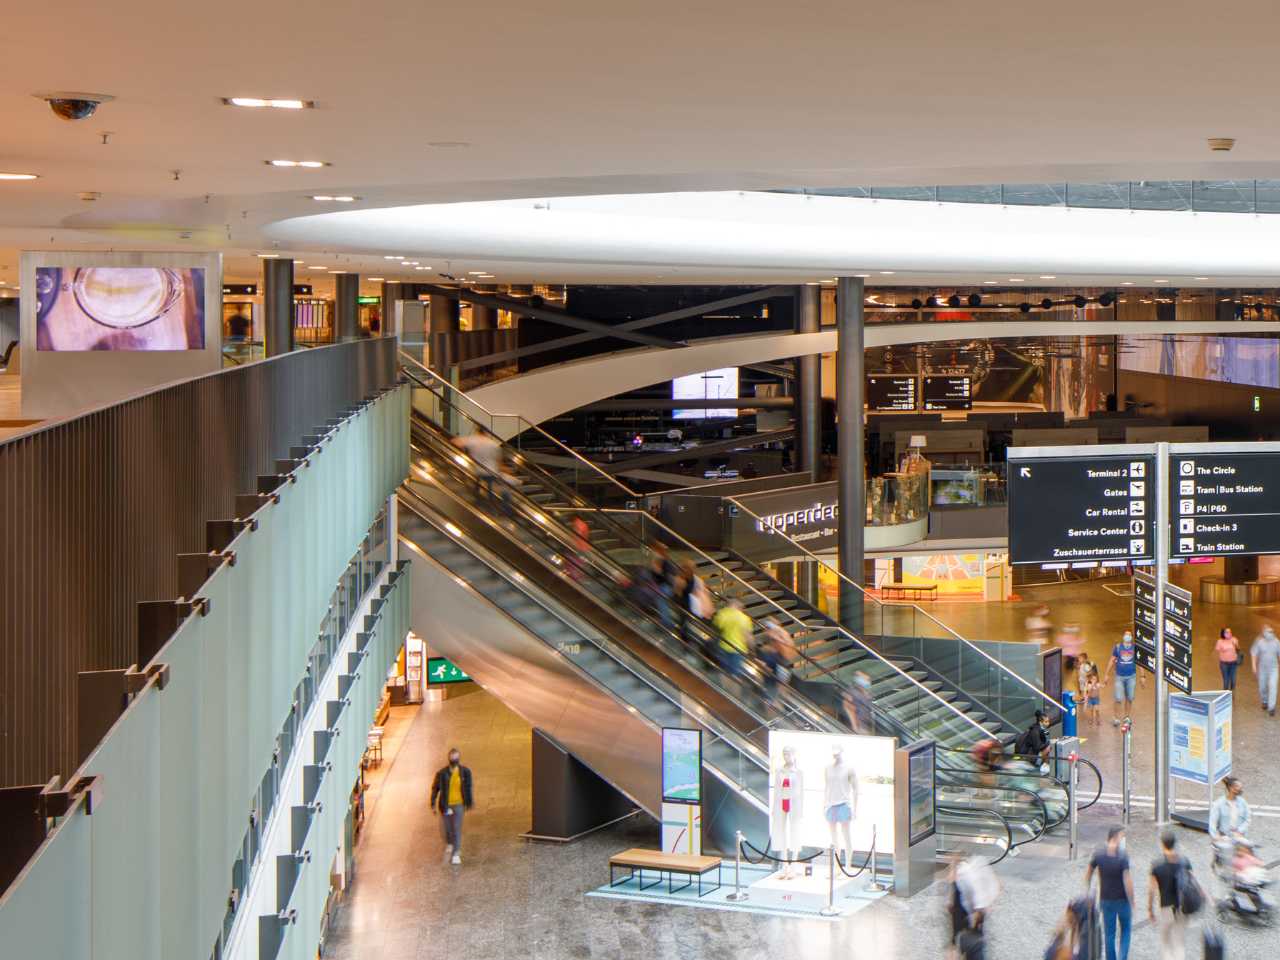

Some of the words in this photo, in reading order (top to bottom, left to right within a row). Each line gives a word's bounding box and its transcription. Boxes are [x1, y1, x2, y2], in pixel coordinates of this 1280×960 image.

[1087, 468, 1120, 478] Terminal
[1122, 469, 1128, 477] 2
[1197, 467, 1211, 475] The
[1213, 466, 1236, 474] Circle
[1235, 485, 1264, 493] Station
[1086, 508, 1100, 516] Car
[1102, 507, 1128, 516] Rental
[1068, 528, 1098, 537] Service
[1100, 527, 1128, 535] Center
[1196, 523, 1230, 532] Check-in
[1232, 523, 1238, 531] 3
[1197, 543, 1215, 551] Train
[1216, 542, 1244, 551] Station
[1053, 547, 1128, 557] Zuschauerterrasse
